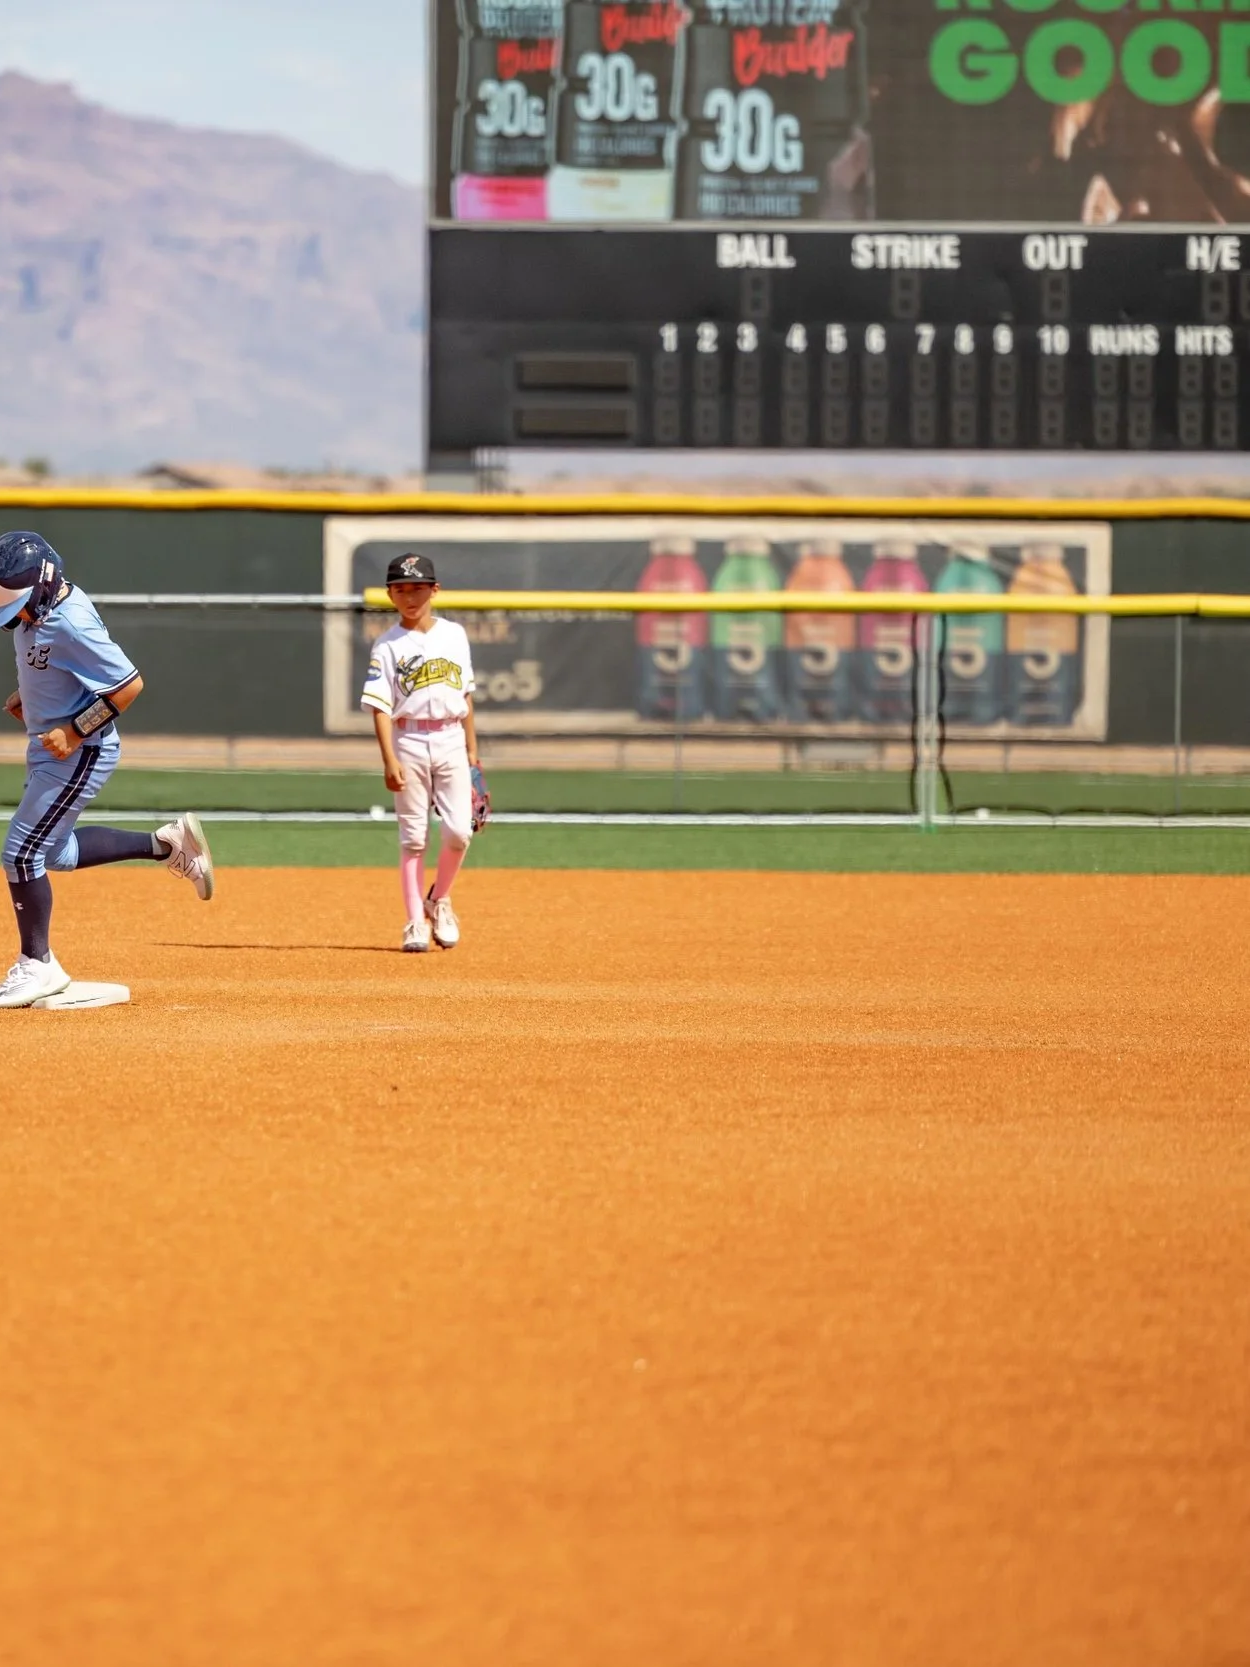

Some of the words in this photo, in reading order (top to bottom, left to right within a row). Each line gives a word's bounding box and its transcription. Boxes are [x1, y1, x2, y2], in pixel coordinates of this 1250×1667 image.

[475, 79, 546, 137] 30G
[576, 52, 659, 121] 30G
[700, 87, 804, 173] 30G
[716, 233, 796, 269] BALL
[851, 233, 961, 270] STRIKE
[1022, 234, 1088, 270] OUT
[1186, 235, 1241, 273] H/E
[659, 322, 678, 353] 1
[696, 321, 719, 353] 2
[736, 321, 758, 353] 3
[785, 323, 808, 354] 4
[826, 323, 848, 354] 5
[865, 323, 886, 354] 6
[915, 323, 936, 355] 7
[954, 323, 974, 355] 8
[993, 323, 1013, 355] 9
[1036, 324, 1070, 355] 10
[1089, 323, 1160, 356] RUNS
[1174, 324, 1234, 357] HITS
[652, 618, 692, 672] 5
[727, 618, 766, 674] 5
[801, 622, 840, 676] 5
[875, 623, 912, 677] 5
[950, 625, 986, 679] 5
[1023, 626, 1060, 680] 5
